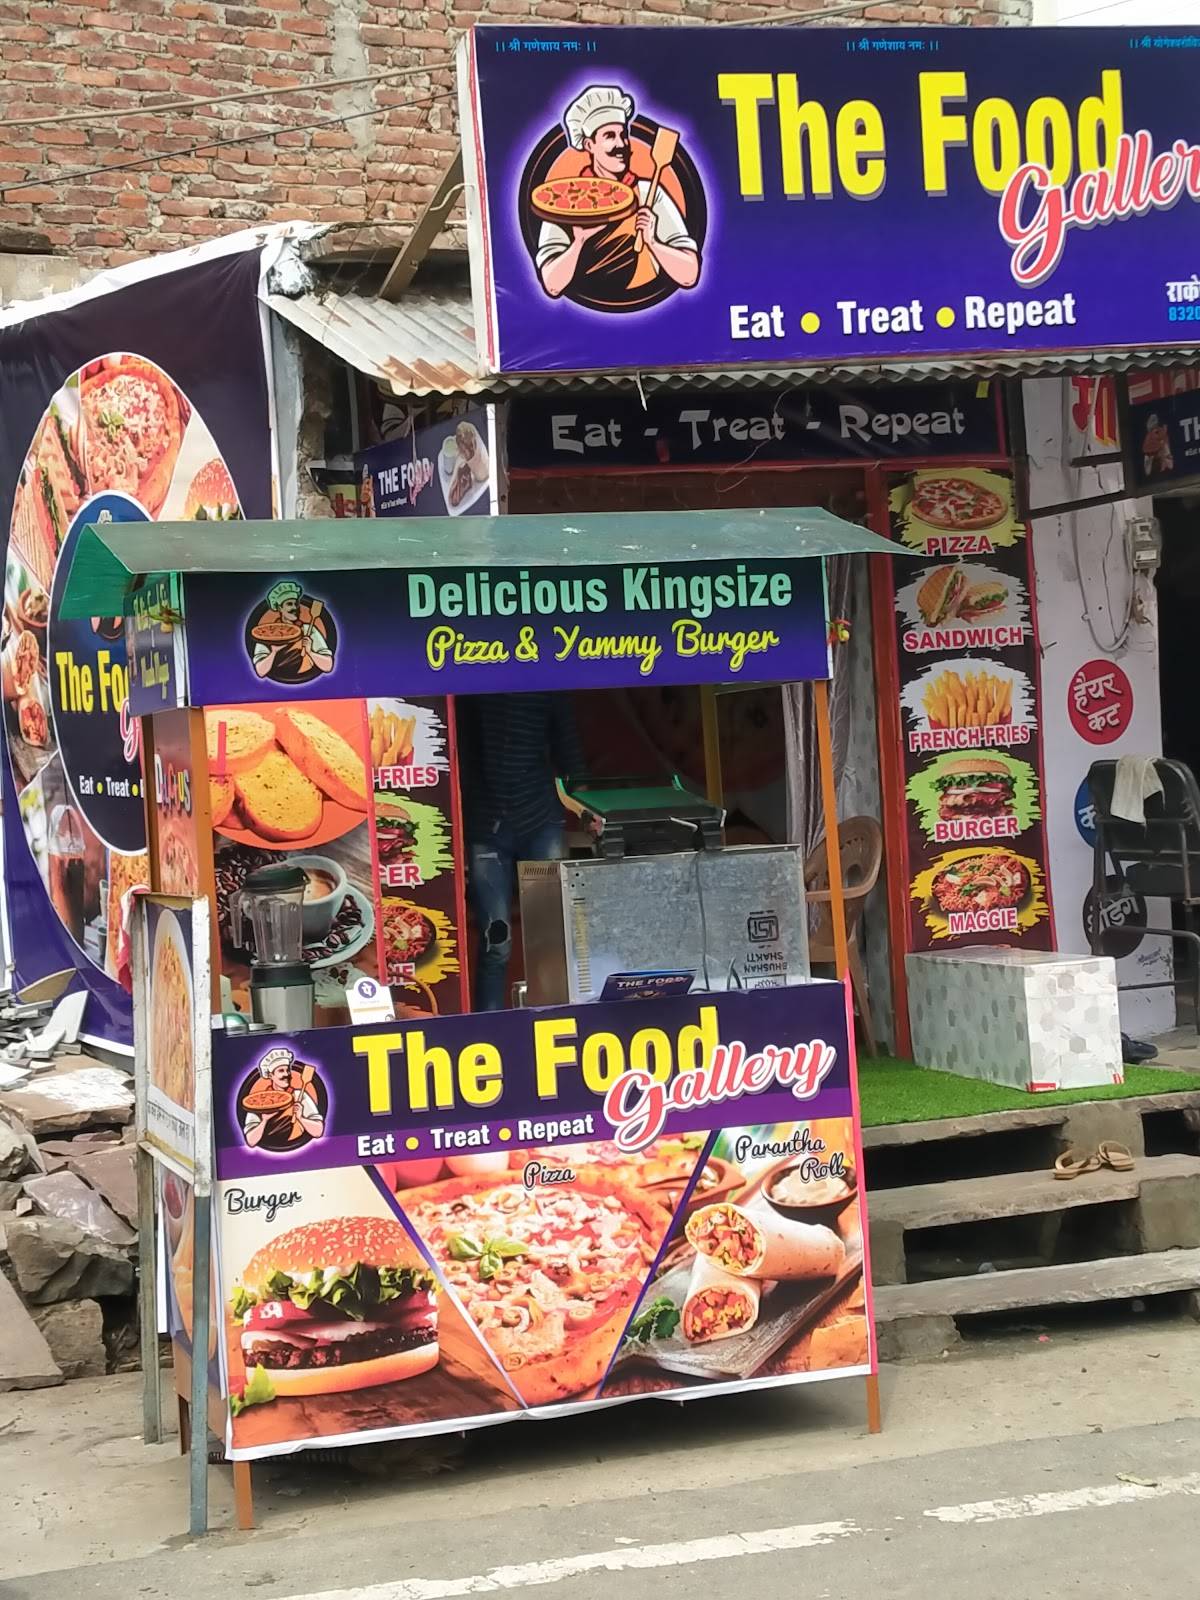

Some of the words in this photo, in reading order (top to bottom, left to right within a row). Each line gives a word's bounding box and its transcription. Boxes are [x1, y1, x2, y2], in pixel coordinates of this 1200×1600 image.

[717, 73, 885, 200] The
[918, 69, 1123, 196] Food
[729, 305, 785, 340] Eat
[836, 298, 923, 335] Treat
[965, 293, 1077, 336] Repeat
[551, 413, 622, 454] Eat
[679, 409, 785, 450] Treat
[838, 404, 966, 443] Repeat
[378, 466, 399, 496] THE
[926, 534, 994, 556] PIZZA
[407, 570, 608, 618] Delicious
[622, 564, 793, 618] Kingsize
[426, 625, 509, 670] Pizza
[514, 625, 541, 663] &
[553, 624, 663, 676] Yammy
[671, 618, 780, 673] Burger
[903, 626, 1024, 652] SANDWICH
[55, 650, 94, 714] The
[1087, 702, 1121, 731] कट
[79, 775, 95, 796] Eat
[105, 776, 130, 798] Treat
[934, 816, 1020, 842] BURGER
[948, 907, 1018, 934] MAGGIE
[746, 951, 784, 962] SHAKTI
[352, 1030, 504, 1116] The
[533, 1005, 721, 1100] Food
[603, 1038, 837, 1153] Gallery
[357, 1132, 395, 1157] Eat
[430, 1124, 490, 1149] Treat
[517, 1113, 595, 1143] Repeat
[735, 1128, 826, 1163] Parantha
[523, 1161, 576, 1192] Pizza
[799, 1152, 846, 1186] Roll
[223, 1186, 302, 1223] Burger
